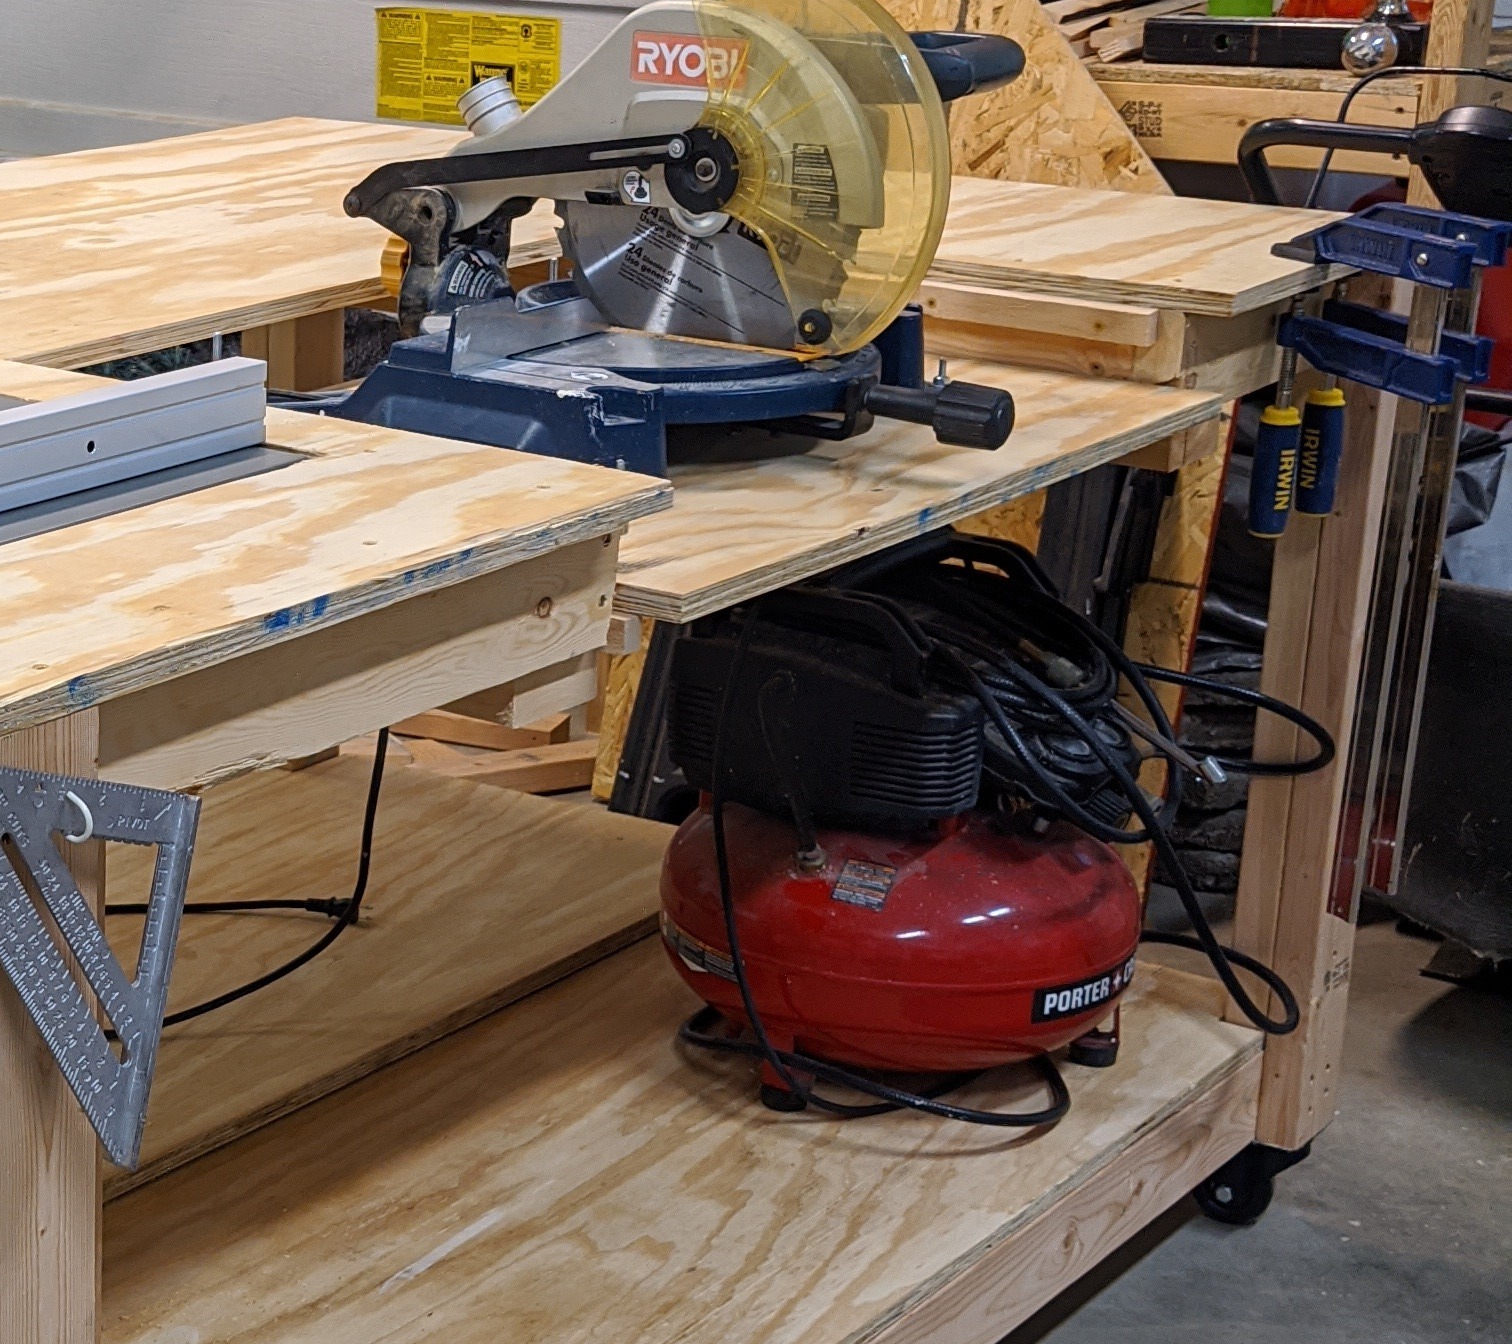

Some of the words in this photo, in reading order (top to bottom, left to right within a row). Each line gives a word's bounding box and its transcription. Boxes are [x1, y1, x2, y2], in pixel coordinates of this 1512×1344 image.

[637, 40, 739, 79] RYOBI
[1300, 429, 1320, 490] IRWIN
[1274, 449, 1296, 510] IRWIN
[117, 814, 151, 831] PIVOT
[1044, 977, 1110, 1015] PORTER
